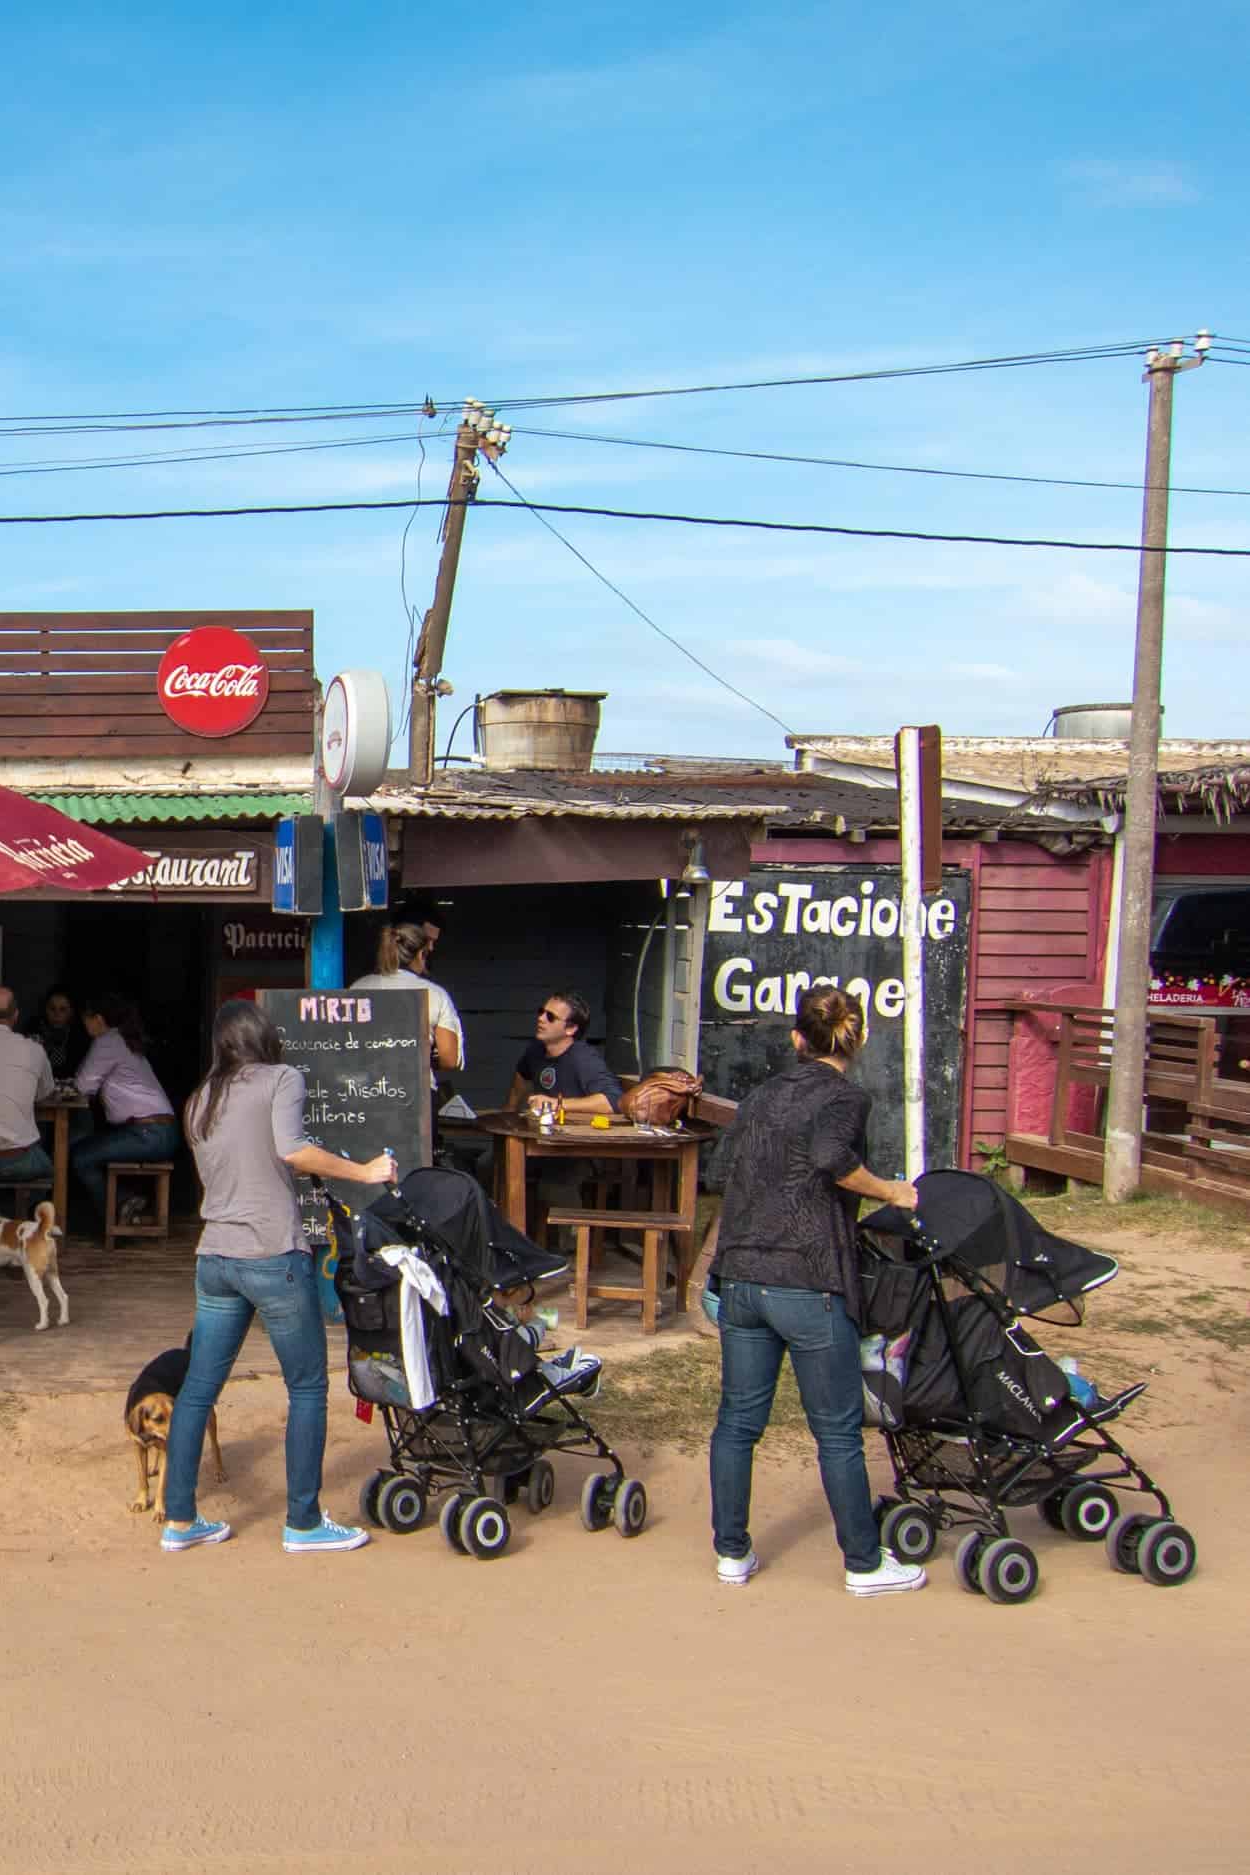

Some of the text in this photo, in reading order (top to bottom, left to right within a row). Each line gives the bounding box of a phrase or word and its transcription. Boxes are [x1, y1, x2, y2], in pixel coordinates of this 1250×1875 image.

[164, 664, 264, 698] Coca-Cola
[276, 846, 293, 885] VISA
[366, 842, 386, 881] VISA
[713, 957, 905, 1044] Garge
[345, 1032, 360, 1050] de
